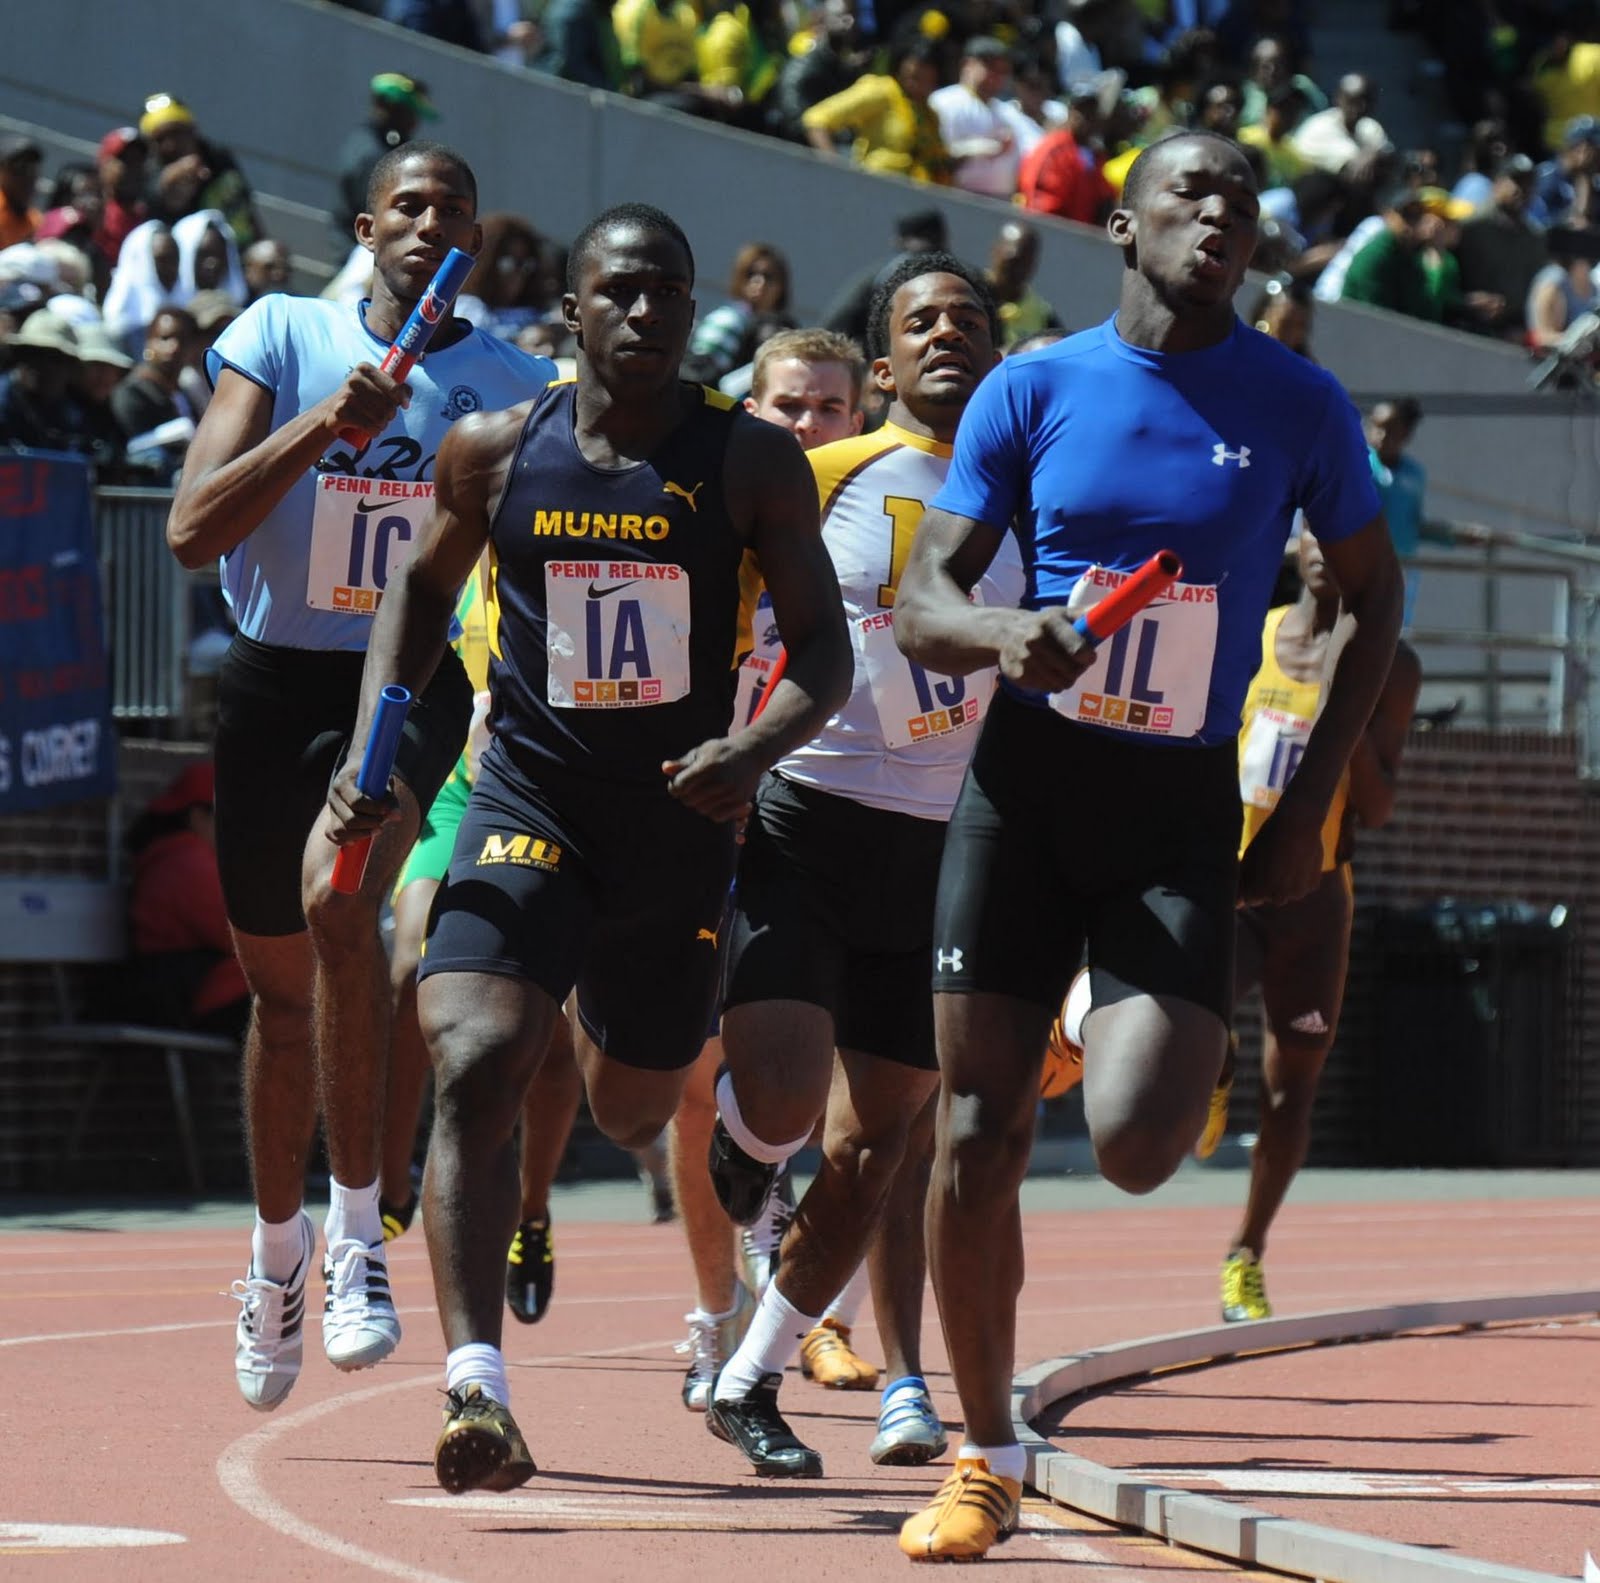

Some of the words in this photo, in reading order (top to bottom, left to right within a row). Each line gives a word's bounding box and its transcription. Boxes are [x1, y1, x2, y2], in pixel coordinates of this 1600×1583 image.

[325, 477, 371, 494] PENN
[379, 482, 435, 498] RELAY
[533, 510, 670, 540] MUNRO
[552, 562, 600, 578] PENN
[608, 563, 680, 580] RELAYS
[862, 612, 893, 633] PEN
